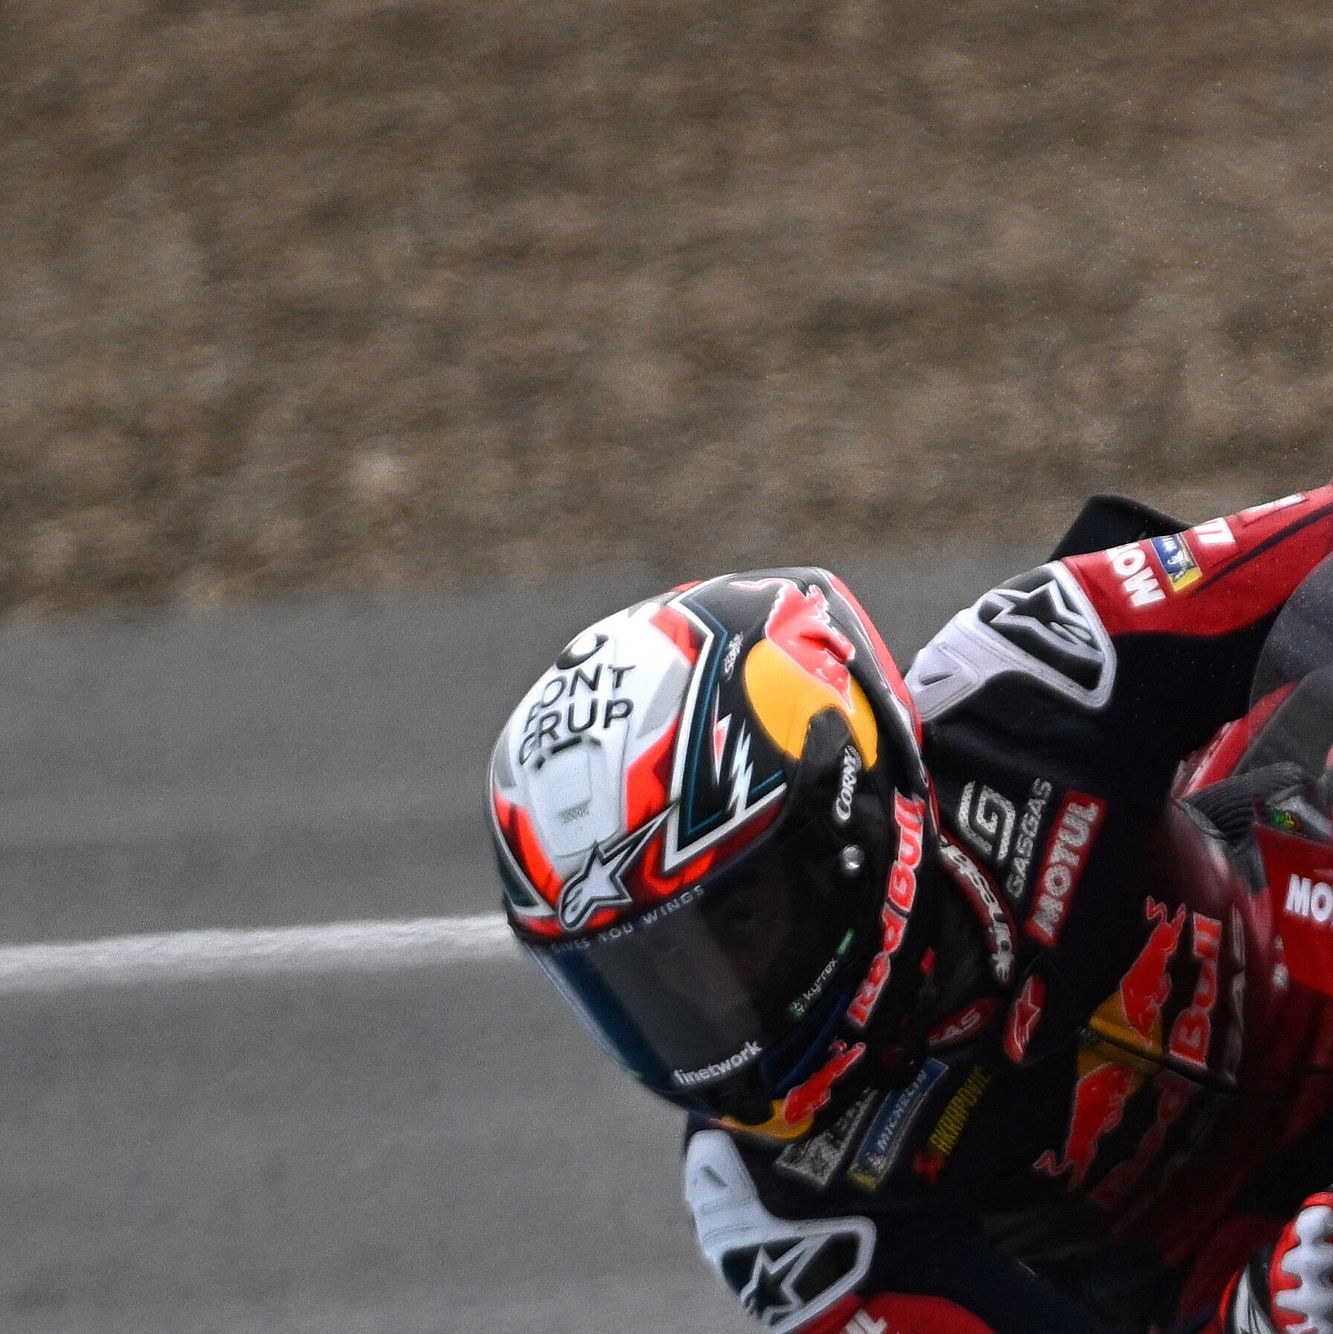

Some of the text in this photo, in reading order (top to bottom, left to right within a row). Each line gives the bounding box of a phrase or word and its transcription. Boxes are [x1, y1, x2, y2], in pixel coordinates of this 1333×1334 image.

[518, 698, 635, 766] GRUP
[523, 663, 636, 733] FONT
[1006, 777, 1053, 898] GASGAS
[1033, 800, 1099, 938] MOTUL
[642, 883, 707, 925] WINGS
